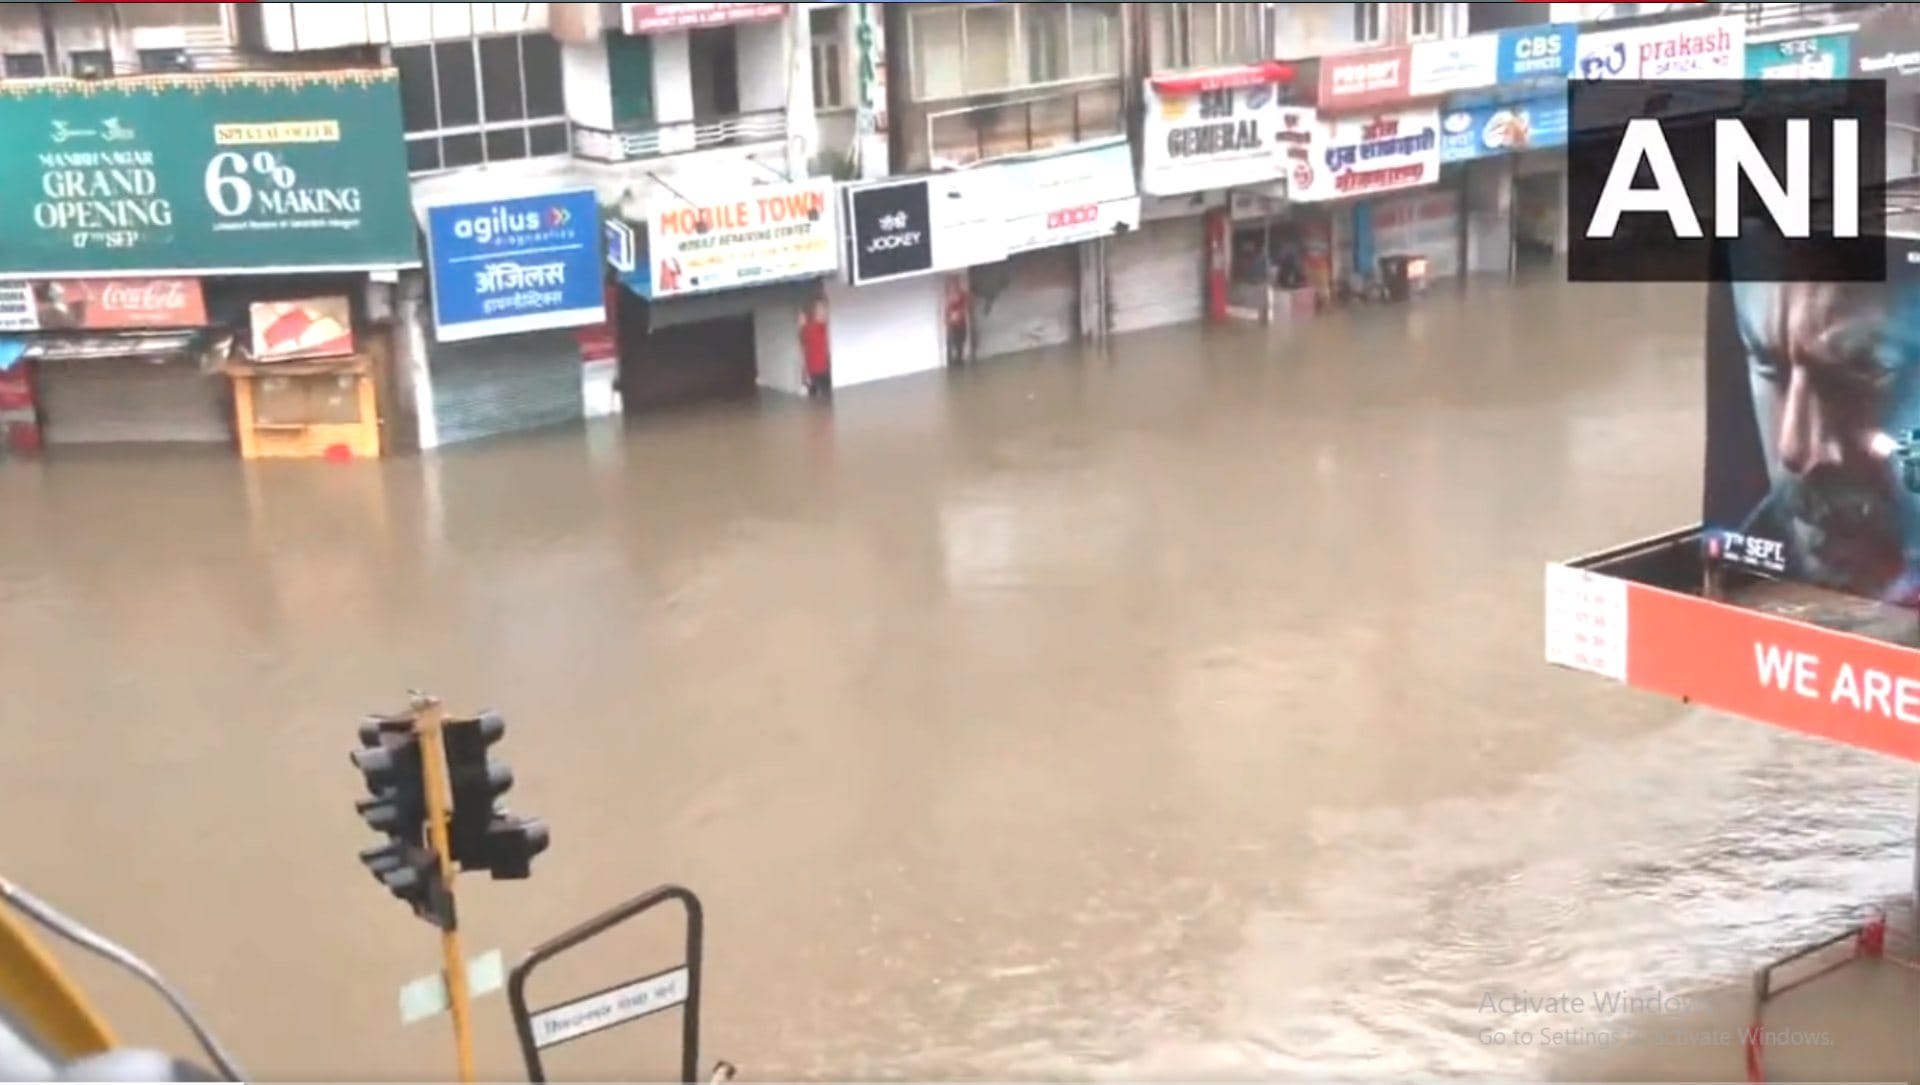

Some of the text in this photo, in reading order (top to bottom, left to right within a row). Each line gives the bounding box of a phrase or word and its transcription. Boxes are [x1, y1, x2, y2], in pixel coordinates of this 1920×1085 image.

[1515, 35, 1562, 59] CBS
[1638, 27, 1731, 80] prakash
[1167, 113, 1263, 158] GENERAL
[42, 168, 156, 198] GRAND
[204, 151, 296, 216] 6%
[257, 187, 361, 215] MAKING
[34, 198, 172, 229] OPENING
[454, 206, 540, 243] agilus
[660, 191, 825, 237] MOBILE TOWN
[866, 231, 921, 253] JOCKEY
[1754, 641, 1920, 724] WE ARE
